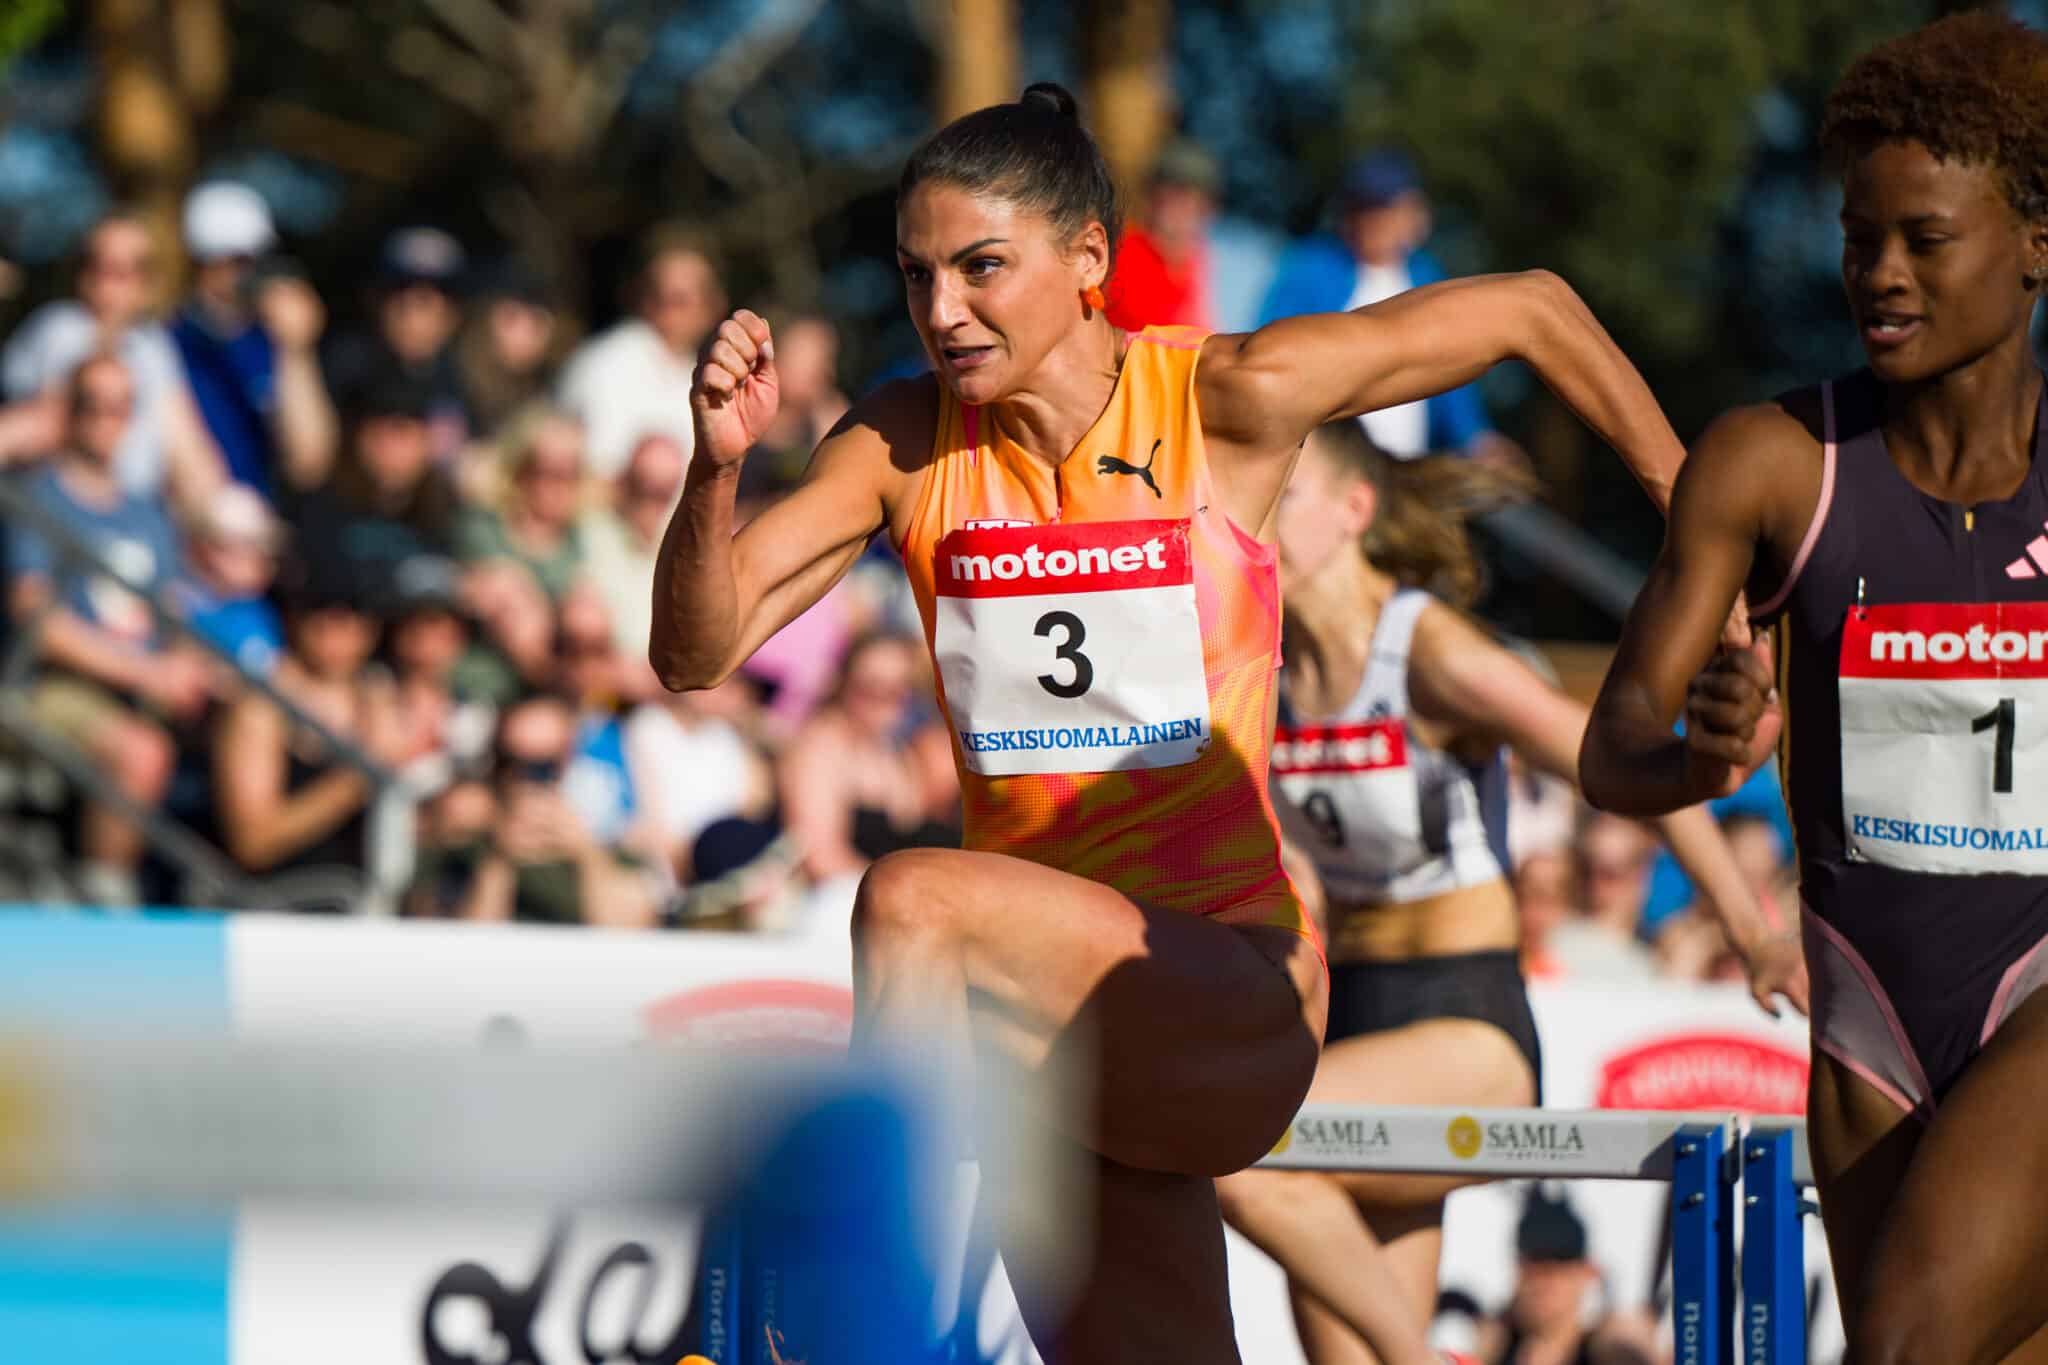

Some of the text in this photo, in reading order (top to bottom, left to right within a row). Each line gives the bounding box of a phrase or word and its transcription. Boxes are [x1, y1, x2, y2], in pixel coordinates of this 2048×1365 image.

[952, 537, 1166, 581] motonet
[1034, 610, 1094, 698] 3
[960, 718, 1202, 752] KESKISUOMALAINEN
[1972, 698, 2015, 793] 1
[1853, 814, 2048, 851] KESKISUOMAL
[1297, 1118, 1389, 1146] SAMLA
[1487, 1122, 1585, 1151] SAMLA
